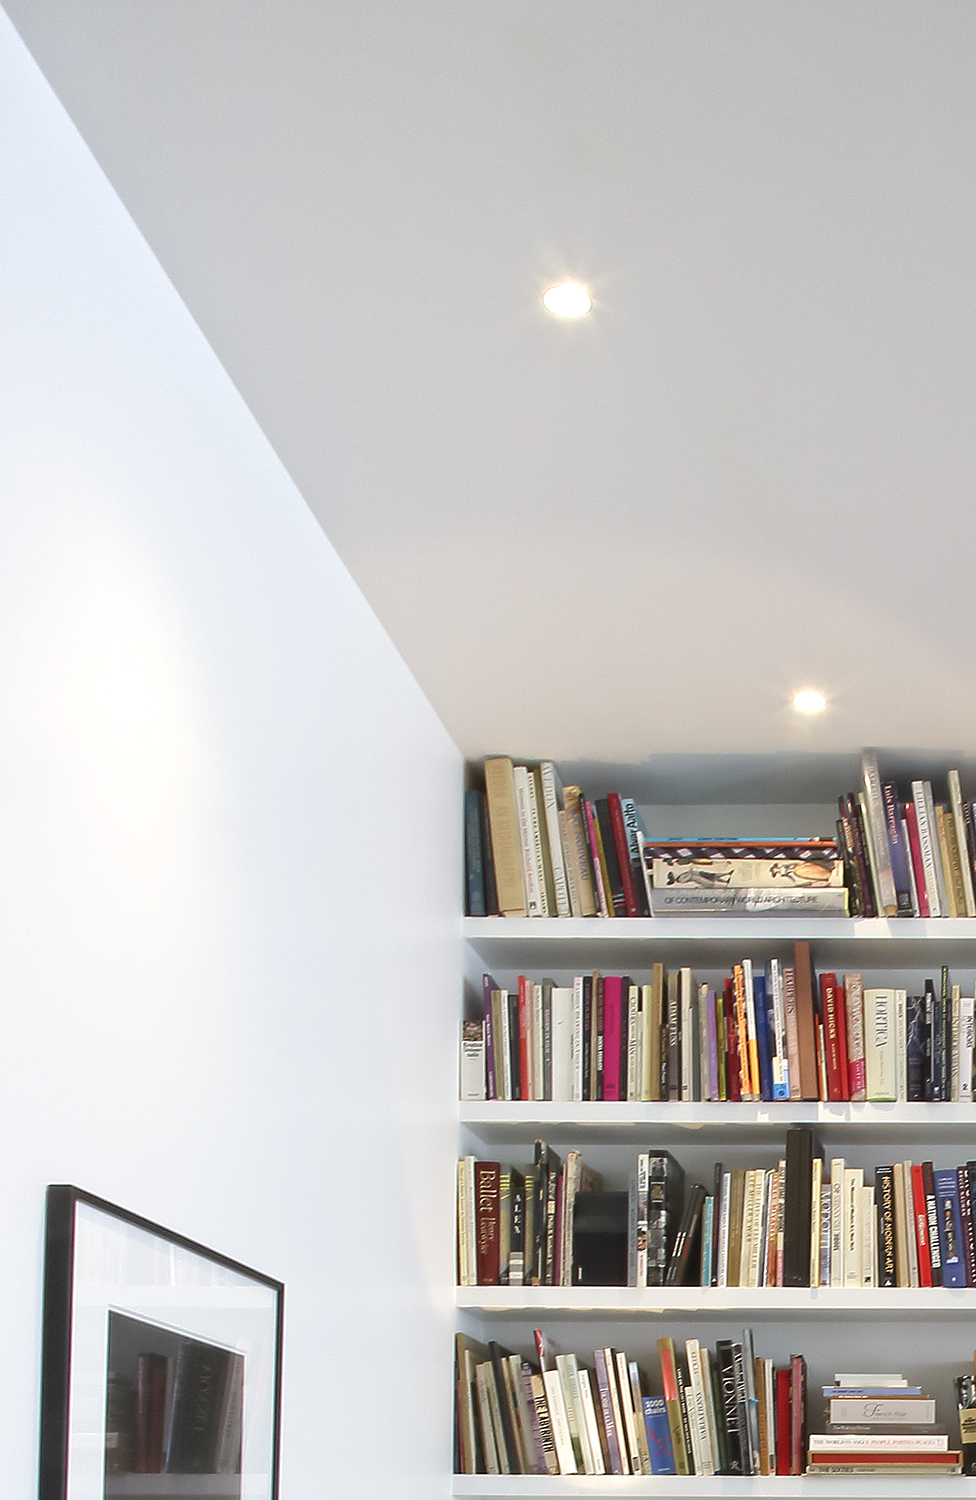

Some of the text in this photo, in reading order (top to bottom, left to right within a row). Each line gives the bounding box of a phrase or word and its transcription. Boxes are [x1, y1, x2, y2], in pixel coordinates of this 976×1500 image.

[575, 830, 589, 881] NOUVEAU
[668, 999, 678, 1047] ADAM FUSS
[826, 988, 834, 1013] DAVID
[478, 1170, 497, 1212] Ballet
[926, 1200, 939, 1225] NATION
[881, 1176, 894, 1274] HISTORY OF MODERN ART
[928, 1226, 941, 1268] CHALLENGED
[534, 1394, 554, 1453] THE LABYRINTH
[722, 1365, 740, 1434] VIONNET
